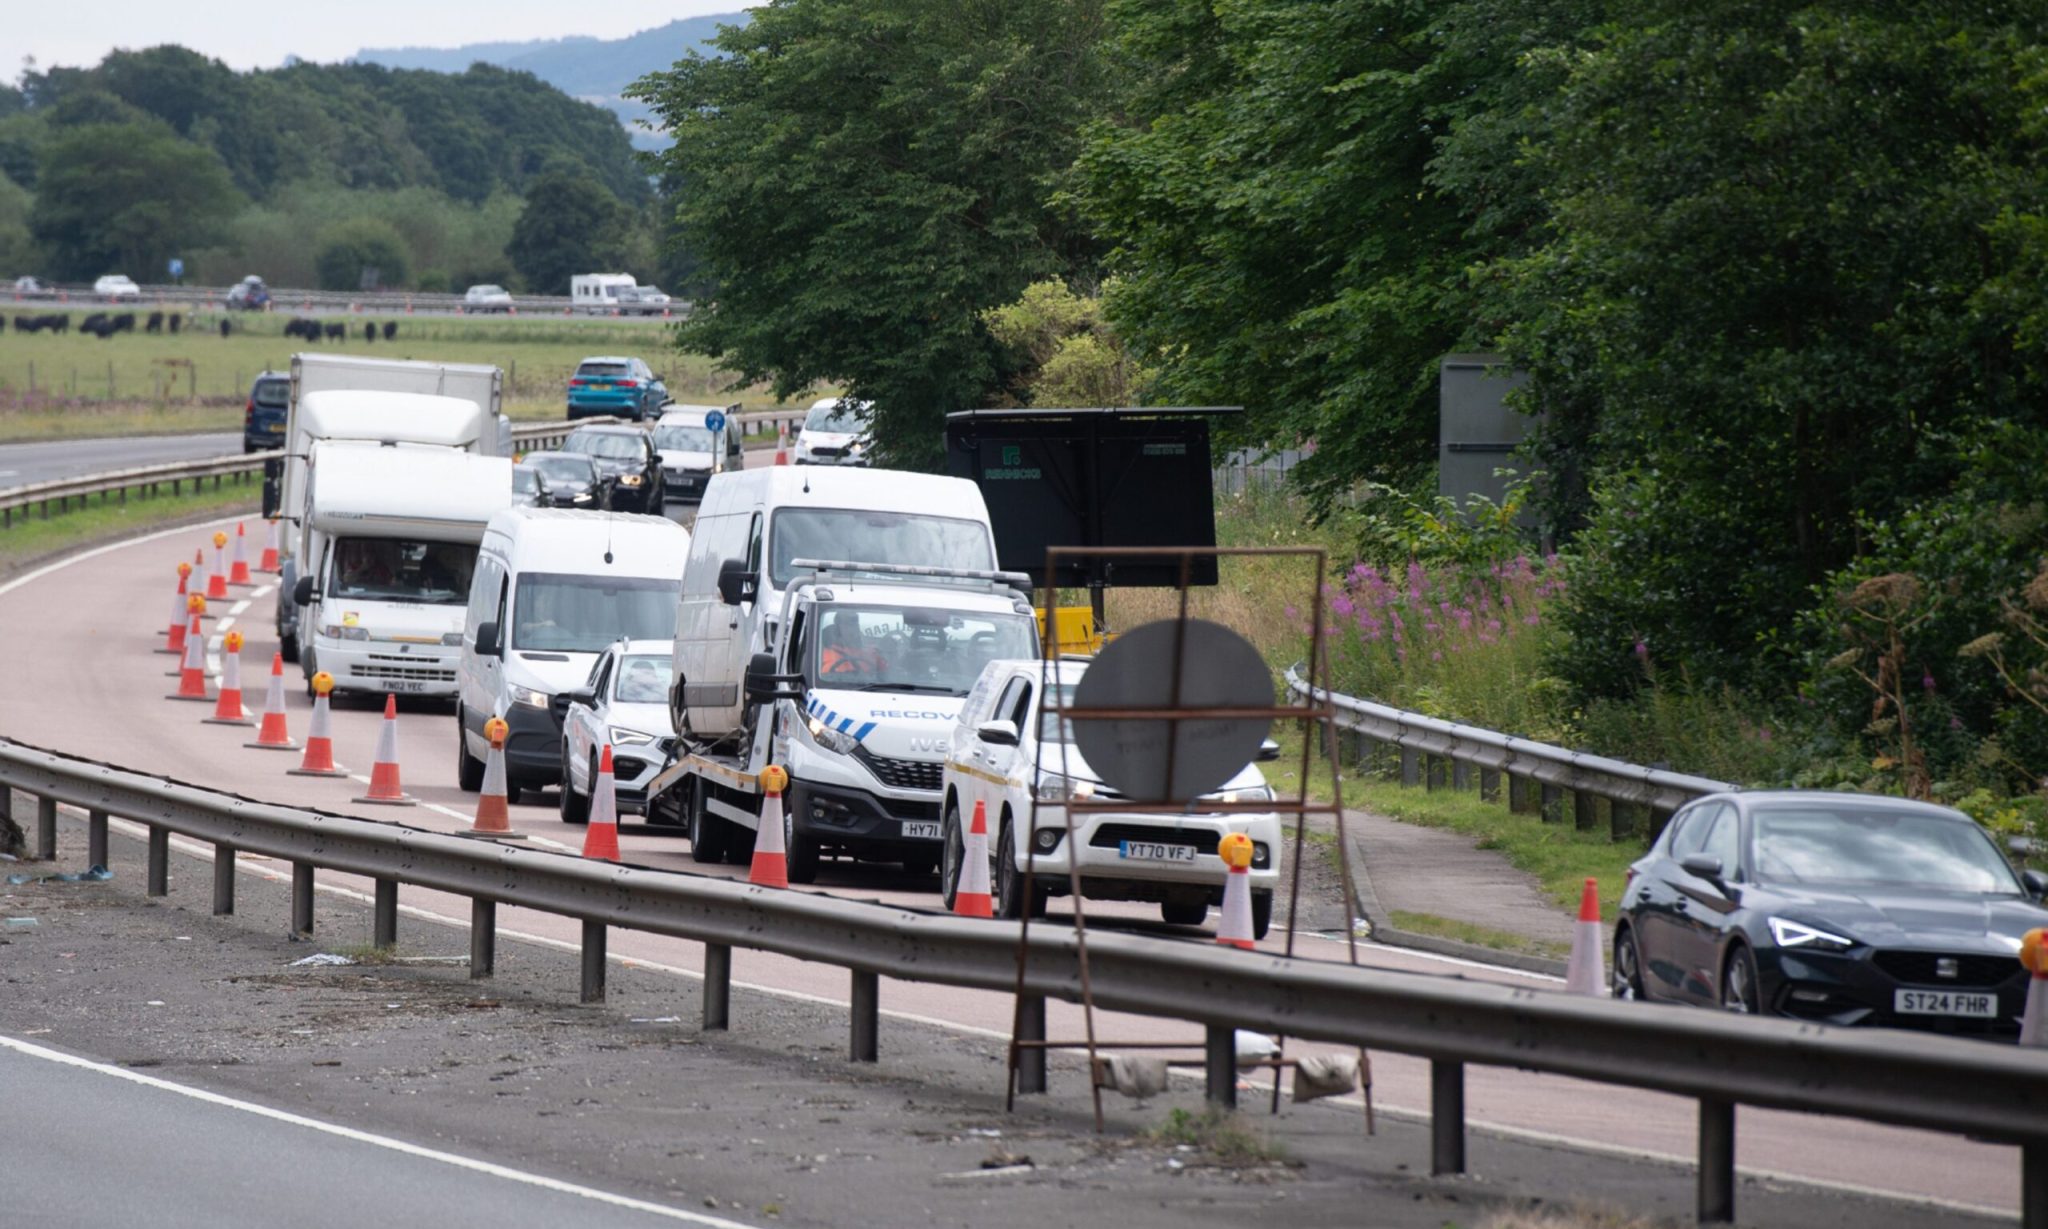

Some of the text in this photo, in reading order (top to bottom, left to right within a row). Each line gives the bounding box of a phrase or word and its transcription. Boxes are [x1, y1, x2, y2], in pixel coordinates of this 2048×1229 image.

[382, 681, 424, 691] FN02 YEC
[870, 709, 959, 721] RECOV
[909, 823, 938, 837] HY71
[1129, 843, 1195, 860] YT70 VFJ
[1903, 992, 1989, 1013] ST24 FHR
